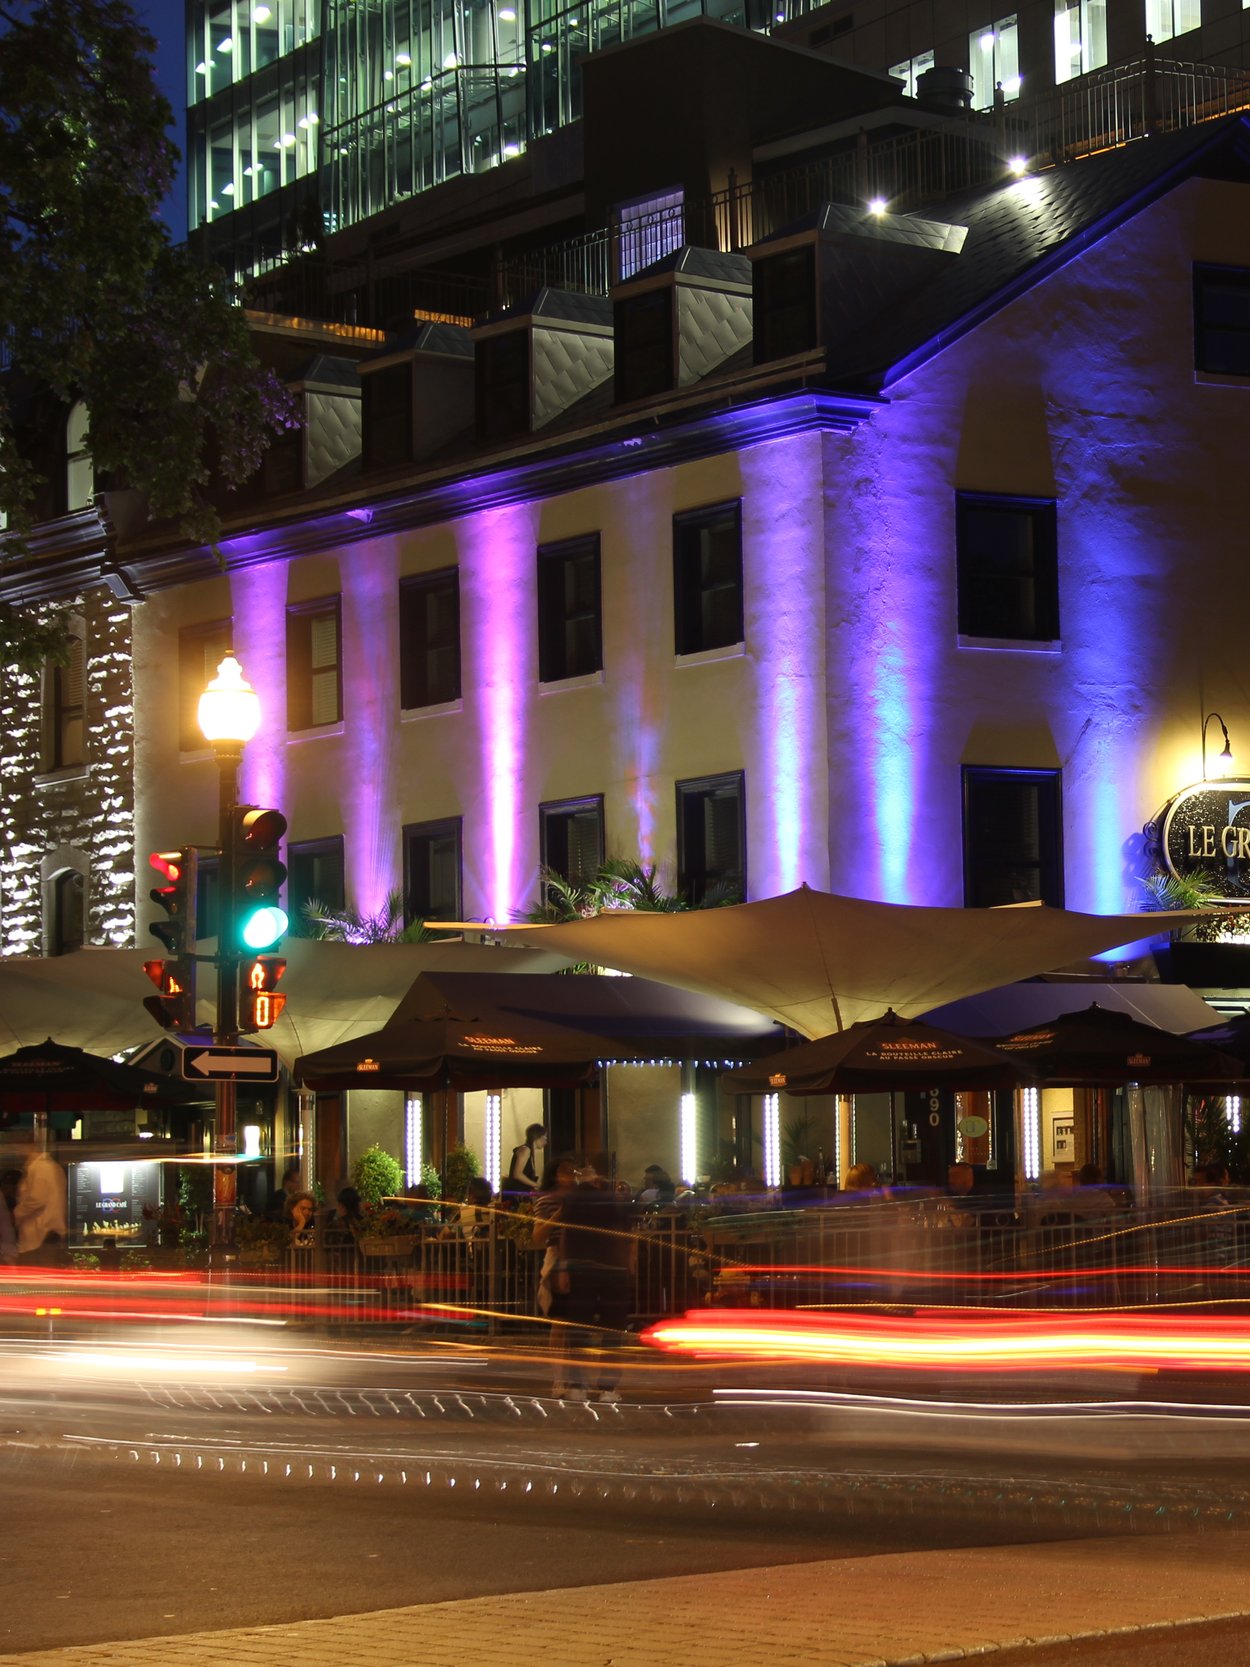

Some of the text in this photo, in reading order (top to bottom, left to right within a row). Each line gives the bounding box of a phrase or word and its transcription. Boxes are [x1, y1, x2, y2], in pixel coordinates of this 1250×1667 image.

[1188, 825, 1217, 858] LE
[256, 996, 269, 1026] 0
[464, 1036, 516, 1045] SLEEMAN
[881, 1042, 937, 1050] SLEEMAN
[356, 1063, 379, 1072] SLEEMAN
